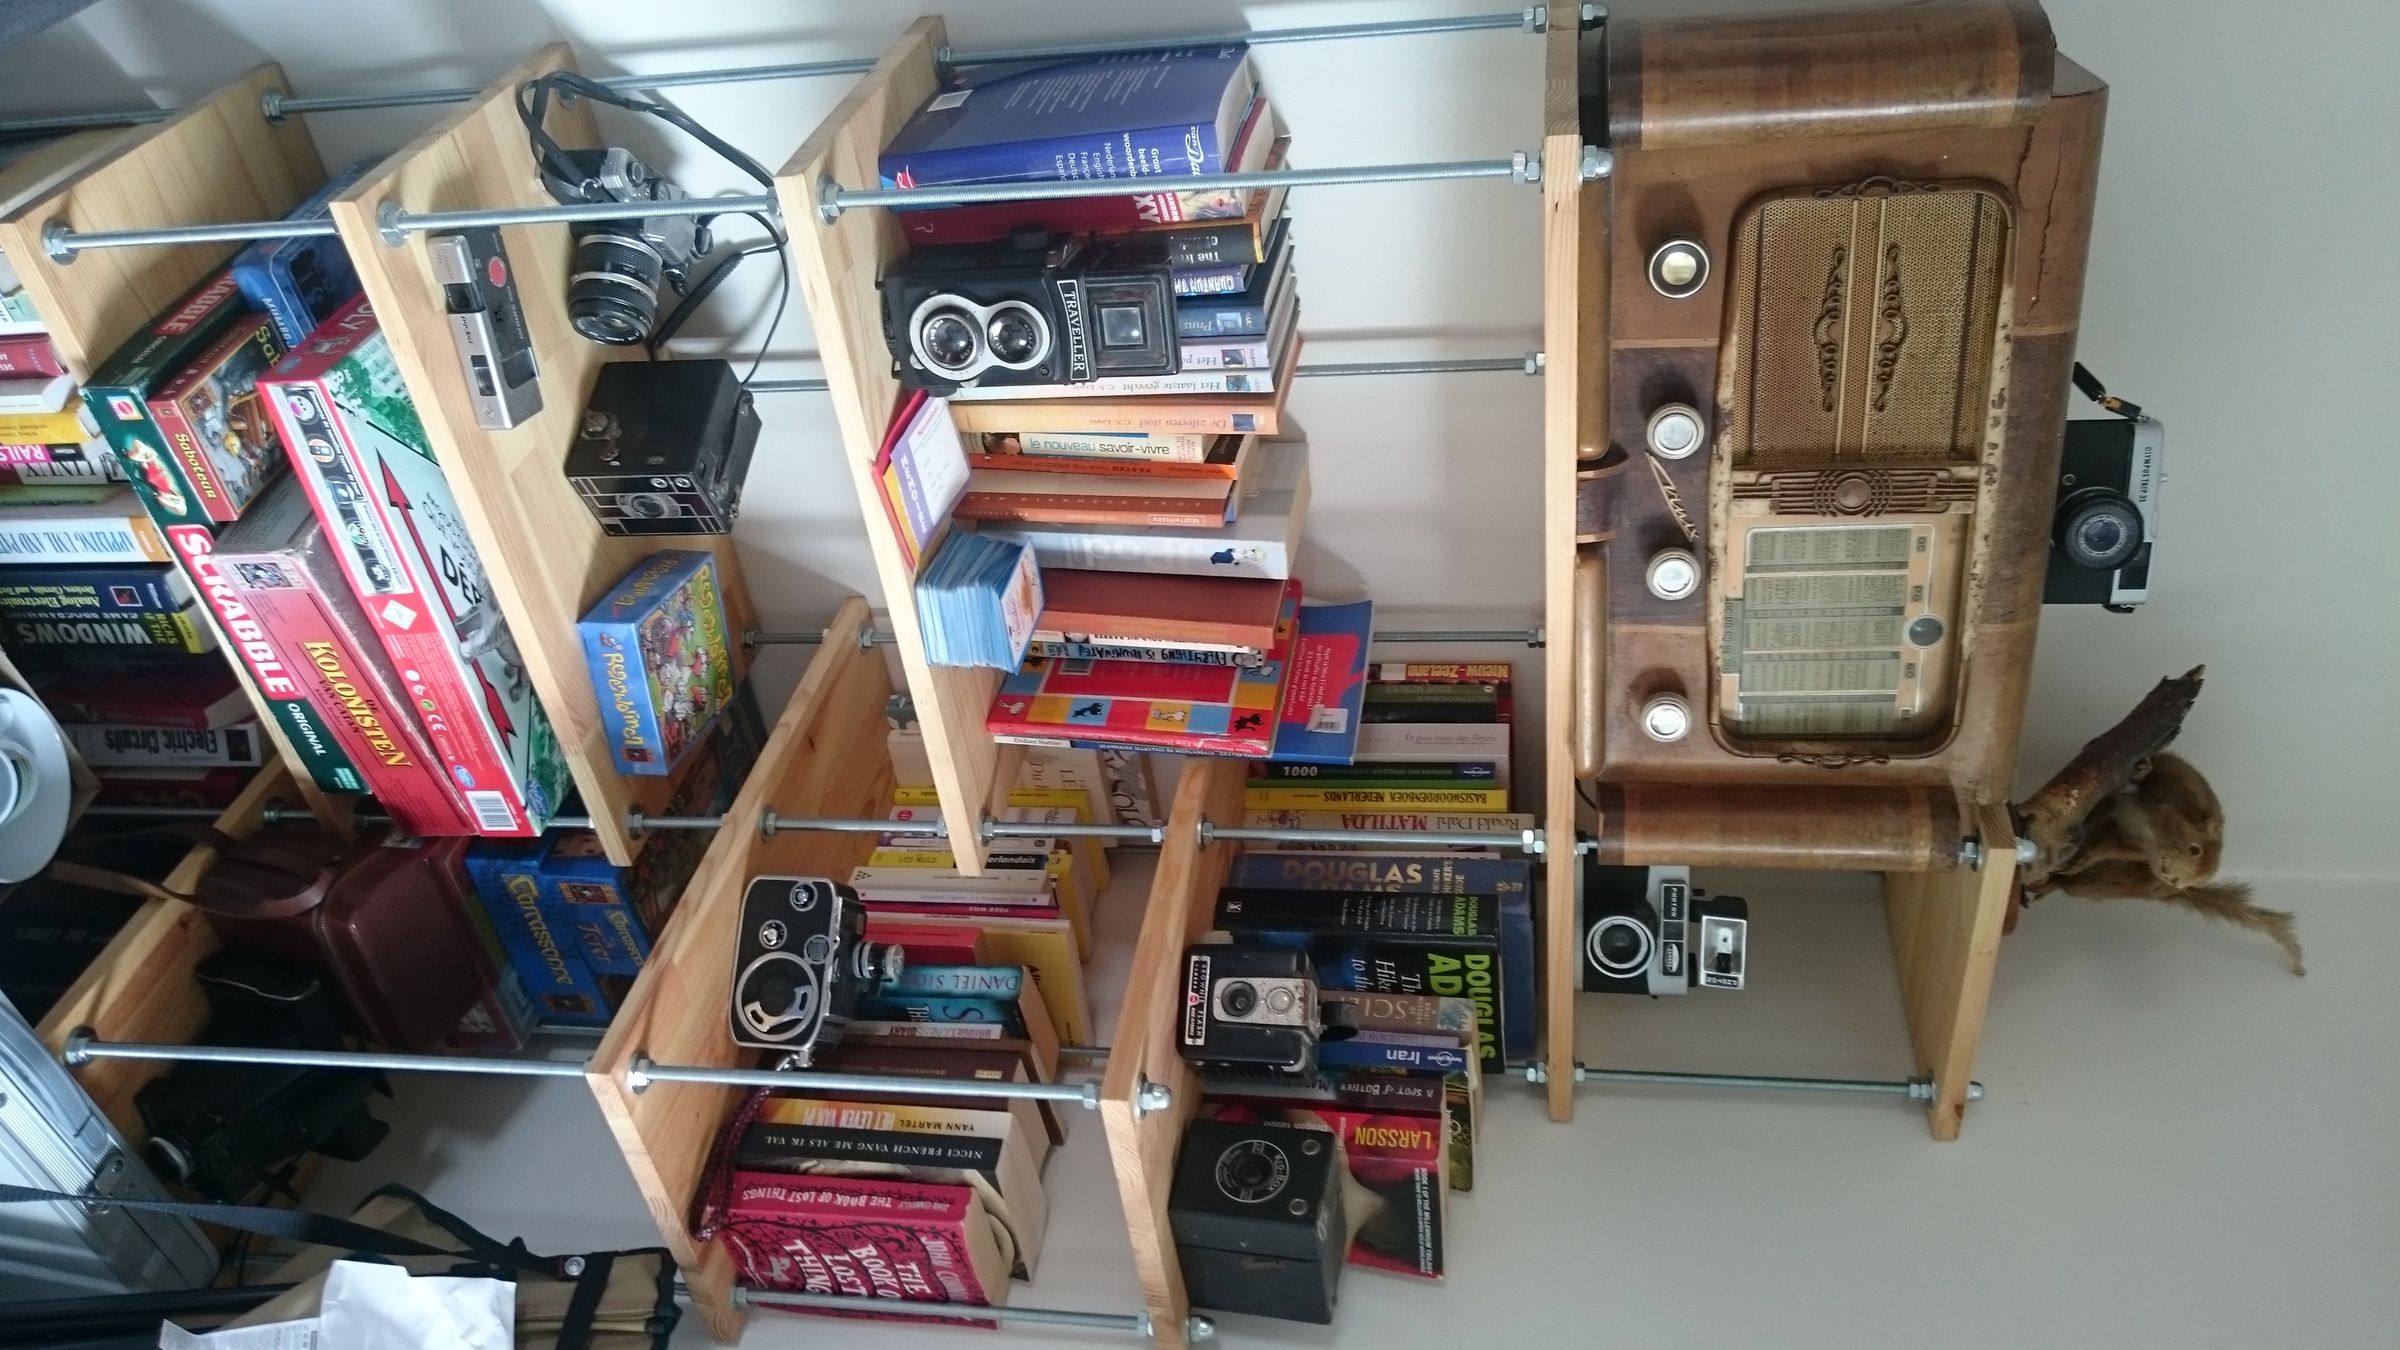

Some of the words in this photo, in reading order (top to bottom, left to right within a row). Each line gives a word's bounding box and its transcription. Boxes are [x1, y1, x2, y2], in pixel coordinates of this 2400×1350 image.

[1190, 126, 1199, 148] van
[1138, 148, 1148, 175] beeld-
[1151, 148, 1162, 173] Groot
[1132, 195, 1160, 224] XY
[1165, 192, 1180, 221] SANDRO
[1197, 251, 1221, 263] The
[1190, 275, 1234, 292] QUANTUM
[1064, 290, 1085, 371] TRAVELLER
[1183, 321, 1212, 331] Prins
[1197, 357, 1217, 366] Het
[1123, 381, 1159, 391] gevecht
[1163, 382, 1196, 390] laatste
[1139, 419, 1162, 429] stoel
[1166, 419, 1206, 429] zilveren
[1209, 419, 1227, 428] De
[1029, 438, 1040, 448] le
[1044, 441, 1096, 453] nouveau
[1099, 443, 1170, 456] savoir-vivre
[175, 432, 217, 499] Saboteur
[2142, 447, 2152, 477] OLYMPUS
[2140, 479, 2149, 494] TRIP
[2139, 495, 2147, 503] 35
[1152, 516, 1200, 525] Maltwhisky
[59, 595, 100, 608] Analog
[1913, 585, 1922, 603] PO
[16, 623, 151, 645] WINDOWS
[157, 614, 177, 645] RICKS
[177, 531, 294, 696] SCRABBLE
[287, 703, 327, 756] ORIGINAL
[303, 640, 412, 768] KOLONISTEN
[318, 679, 335, 700] VAN
[333, 702, 362, 734] CATAN
[103, 729, 160, 753] Circuits
[162, 730, 218, 754] Electric
[1283, 766, 1318, 776] 1000
[1324, 791, 1385, 802] NEDERLANDS
[1389, 792, 1487, 803] BASISWOORDENBOEK
[1340, 814, 1428, 830] MATILDA
[1436, 816, 1473, 831] Dahl
[1475, 816, 1520, 831] Roald
[988, 855, 1036, 863] erlandais
[1282, 860, 1424, 885] DOUGLAS
[1453, 896, 1465, 936] ADAMS
[1468, 896, 1479, 935] DOUGLAS
[501, 874, 574, 986] Carcassonne
[1351, 959, 1367, 970] to
[952, 975, 1018, 992] DANIEL
[1199, 964, 1207, 1003] BROWNIE
[889, 1027, 917, 1037] DIARY
[1386, 1049, 1421, 1065] Iran
[1340, 1083, 1380, 1096] BOTHER
[1382, 1085, 1394, 1094] of
[1397, 1086, 1422, 1097] SPOT
[1426, 1089, 1434, 1097] A
[839, 1109, 874, 1128] LEVEN
[875, 1112, 896, 1129] HET
[898, 1119, 942, 1130] MARTEL
[946, 1122, 975, 1132] YANN
[764, 1136, 786, 1145] VAL
[791, 1137, 805, 1146] IK
[809, 1139, 829, 1148] ALS
[1355, 1126, 1431, 1149] LARSSON
[834, 1141, 854, 1150] ME
[857, 1142, 888, 1152] VANG
[893, 1144, 943, 1156] FRENCH
[946, 1149, 983, 1159] NICCI
[742, 1187, 786, 1201] THINGS
[788, 1190, 816, 1204] LOST
[818, 1191, 832, 1204] OF
[833, 1192, 868, 1207] BOOK
[869, 1196, 892, 1208] THE
[1421, 1168, 1429, 1186] BOOK
[1425, 1249, 1433, 1274] TRILOGY
[920, 1236, 953, 1268] JOHN
[781, 1239, 832, 1294] THING
[847, 1243, 901, 1287] BOOK
[820, 1253, 868, 1296] LOST
[894, 1261, 933, 1295] THE
